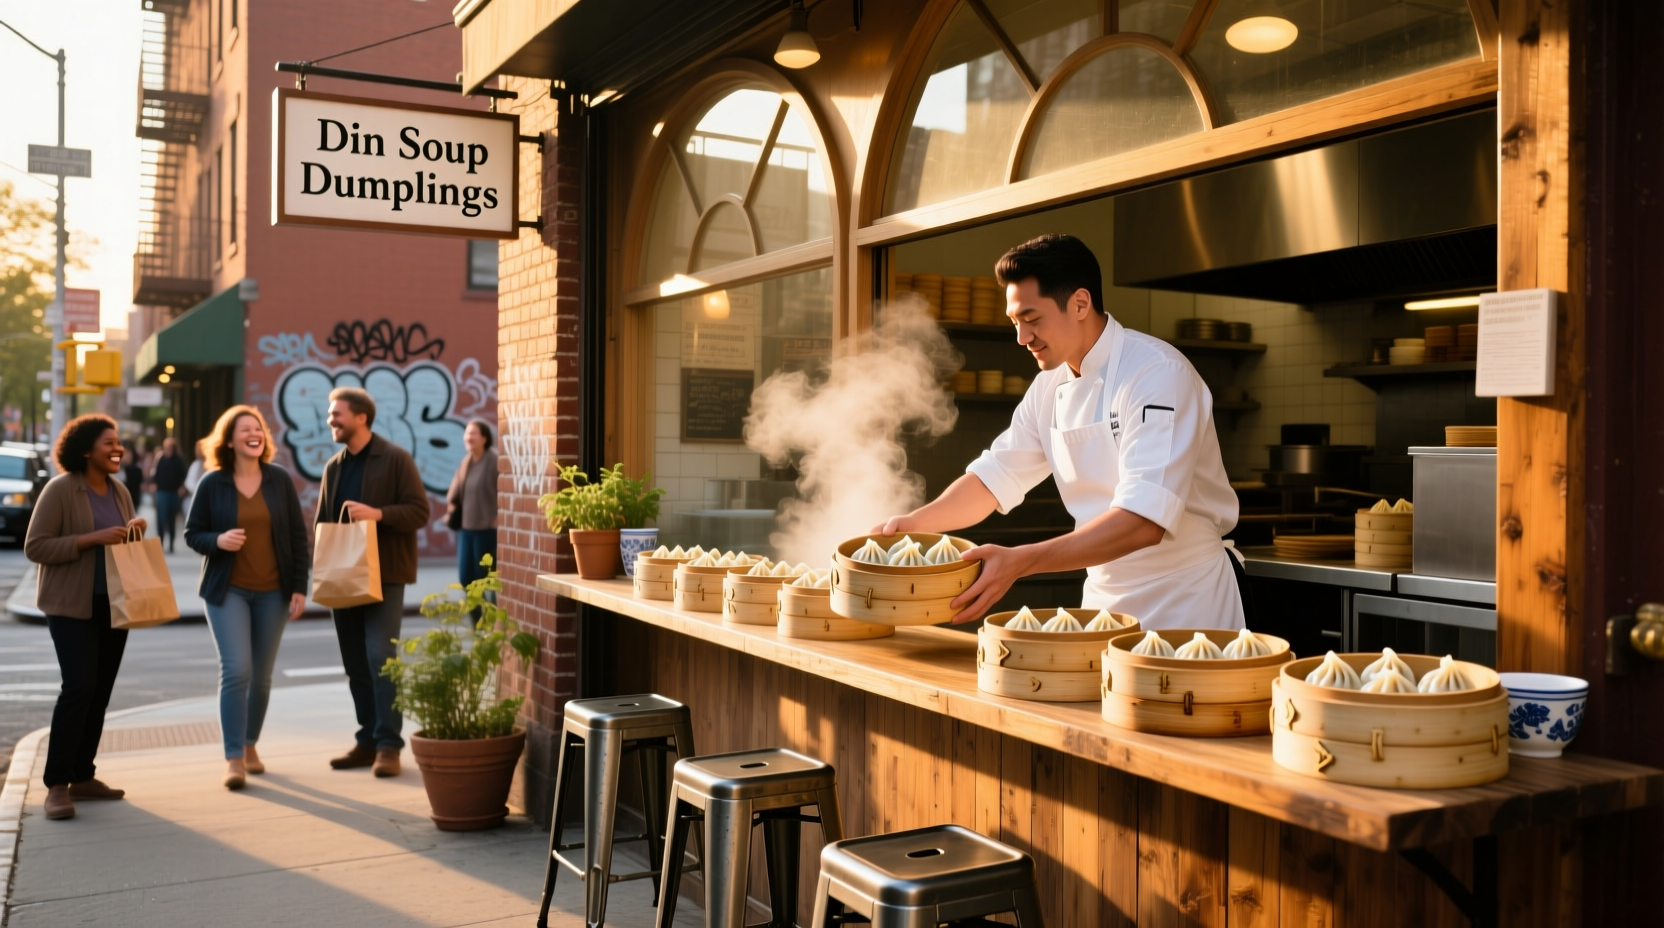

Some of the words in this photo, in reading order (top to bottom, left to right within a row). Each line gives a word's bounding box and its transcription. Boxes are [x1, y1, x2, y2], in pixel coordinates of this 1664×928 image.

[316, 118, 385, 157] Din
[398, 126, 489, 175] Soup
[300, 161, 498, 218] Dumplings
